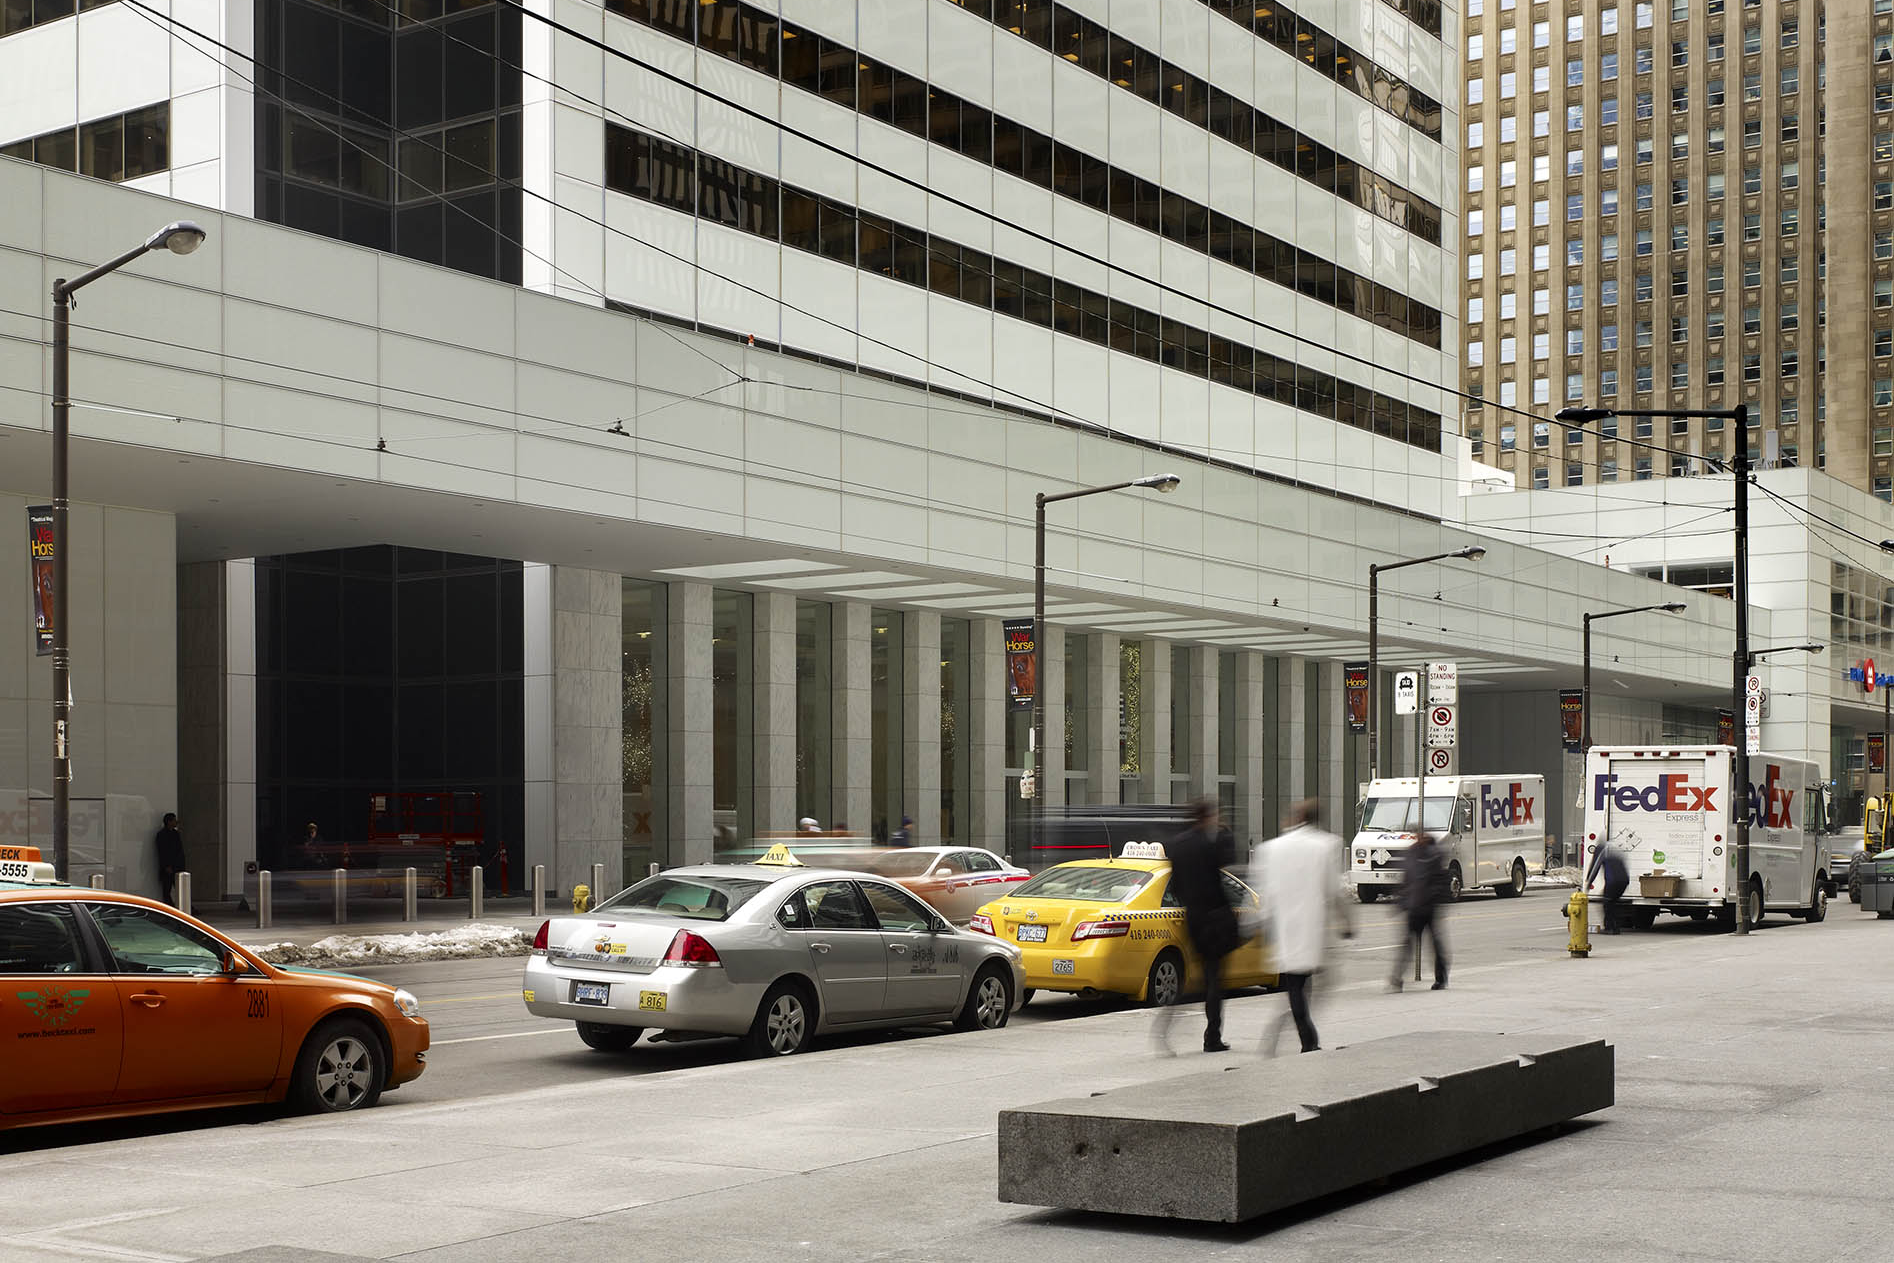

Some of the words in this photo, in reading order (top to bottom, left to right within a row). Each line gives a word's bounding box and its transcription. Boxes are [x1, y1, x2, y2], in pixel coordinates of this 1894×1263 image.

[36, 527, 54, 543] Wa
[32, 540, 54, 556] Hors
[1011, 632, 1030, 641] War
[1006, 640, 1035, 651] Horse
[1346, 678, 1368, 686] Horse
[1594, 774, 1719, 812] FedEx
[1481, 783, 1535, 828] FedEx
[1665, 813, 1699, 822] Express
[0, 849, 20, 860] ECK
[1130, 930, 1141, 940] 416
[1143, 929, 1171, 939] 240-0000
[1055, 962, 1072, 972] 2765
[247, 989, 270, 1018] 2881
[646, 996, 662, 1008] 816
